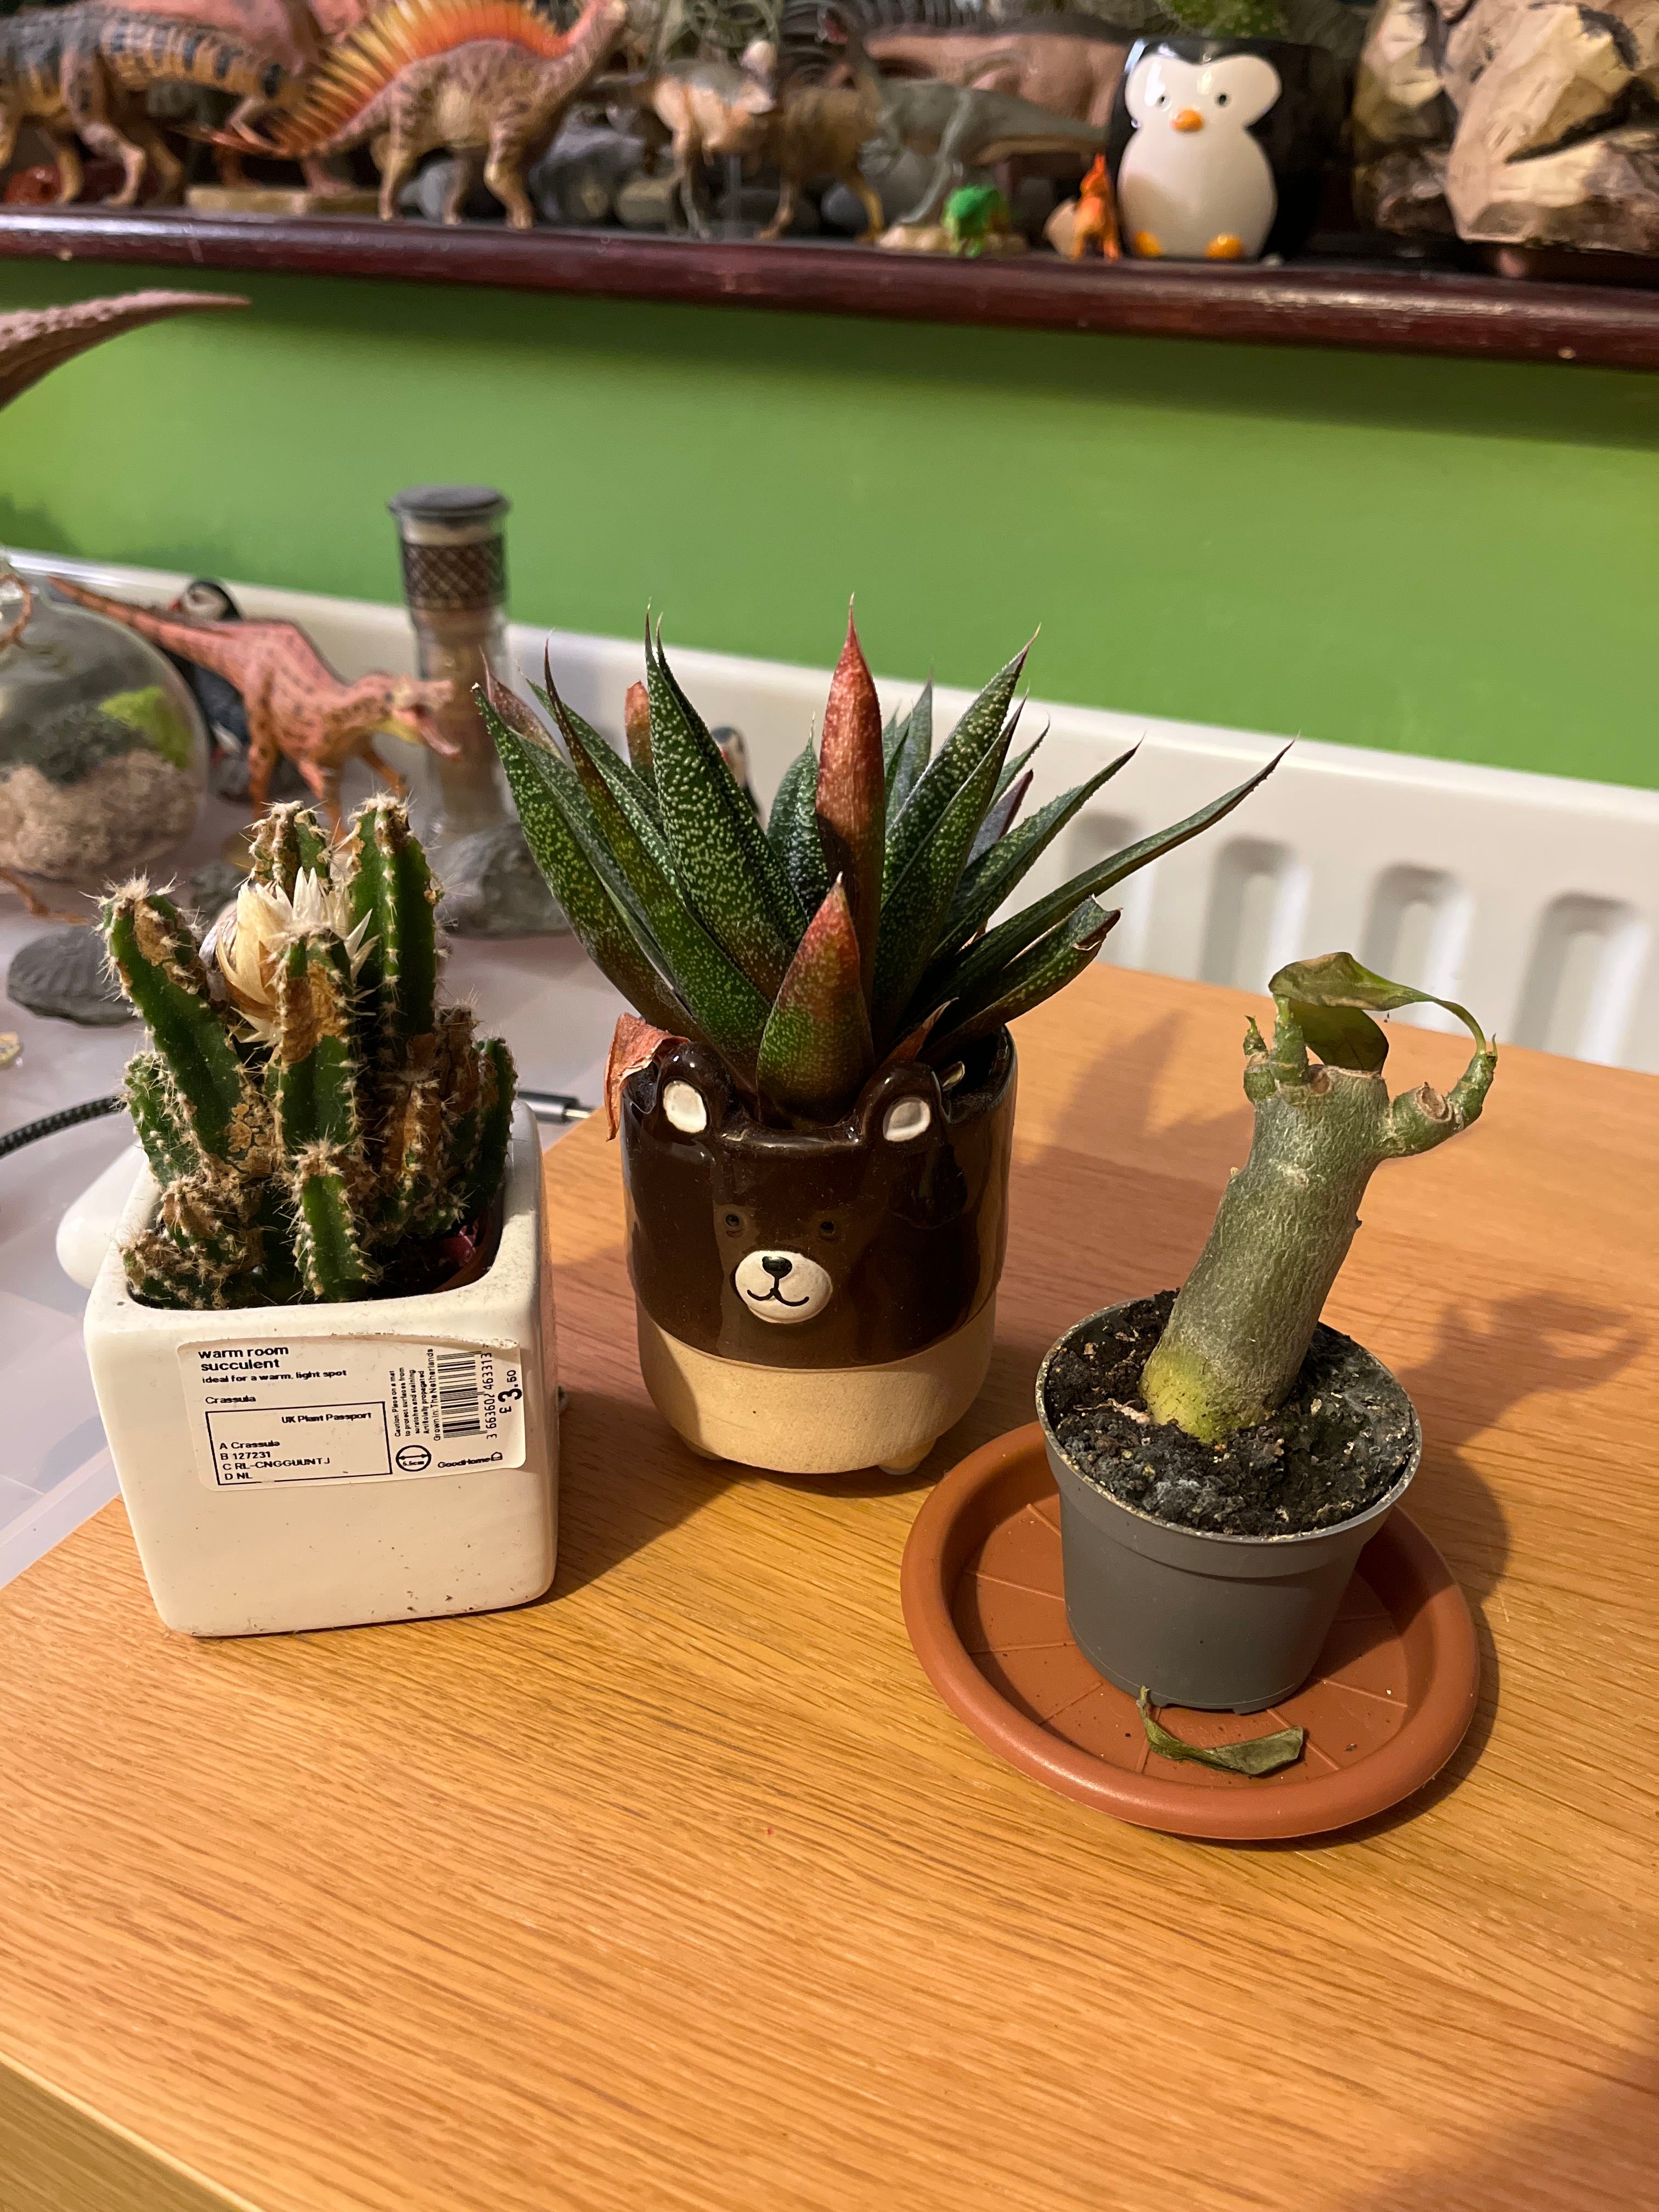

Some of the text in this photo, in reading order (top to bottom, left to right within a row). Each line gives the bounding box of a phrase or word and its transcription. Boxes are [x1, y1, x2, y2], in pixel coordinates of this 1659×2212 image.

[198, 1347, 289, 1359] warm room
[201, 1359, 280, 1372] succulent
[427, 1348, 437, 1394] Netherlands
[481, 1352, 494, 1390] 463313
[202, 1375, 229, 1384] ideal
[296, 1371, 320, 1380] light
[323, 1369, 347, 1379] spot
[205, 1395, 257, 1404] Crassula
[430, 1394, 439, 1408] The
[281, 1412, 372, 1424] UK Plant Passport
[231, 1440, 280, 1449] Crassula
[233, 1451, 271, 1460] 127231
[222, 1463, 232, 1471] C
